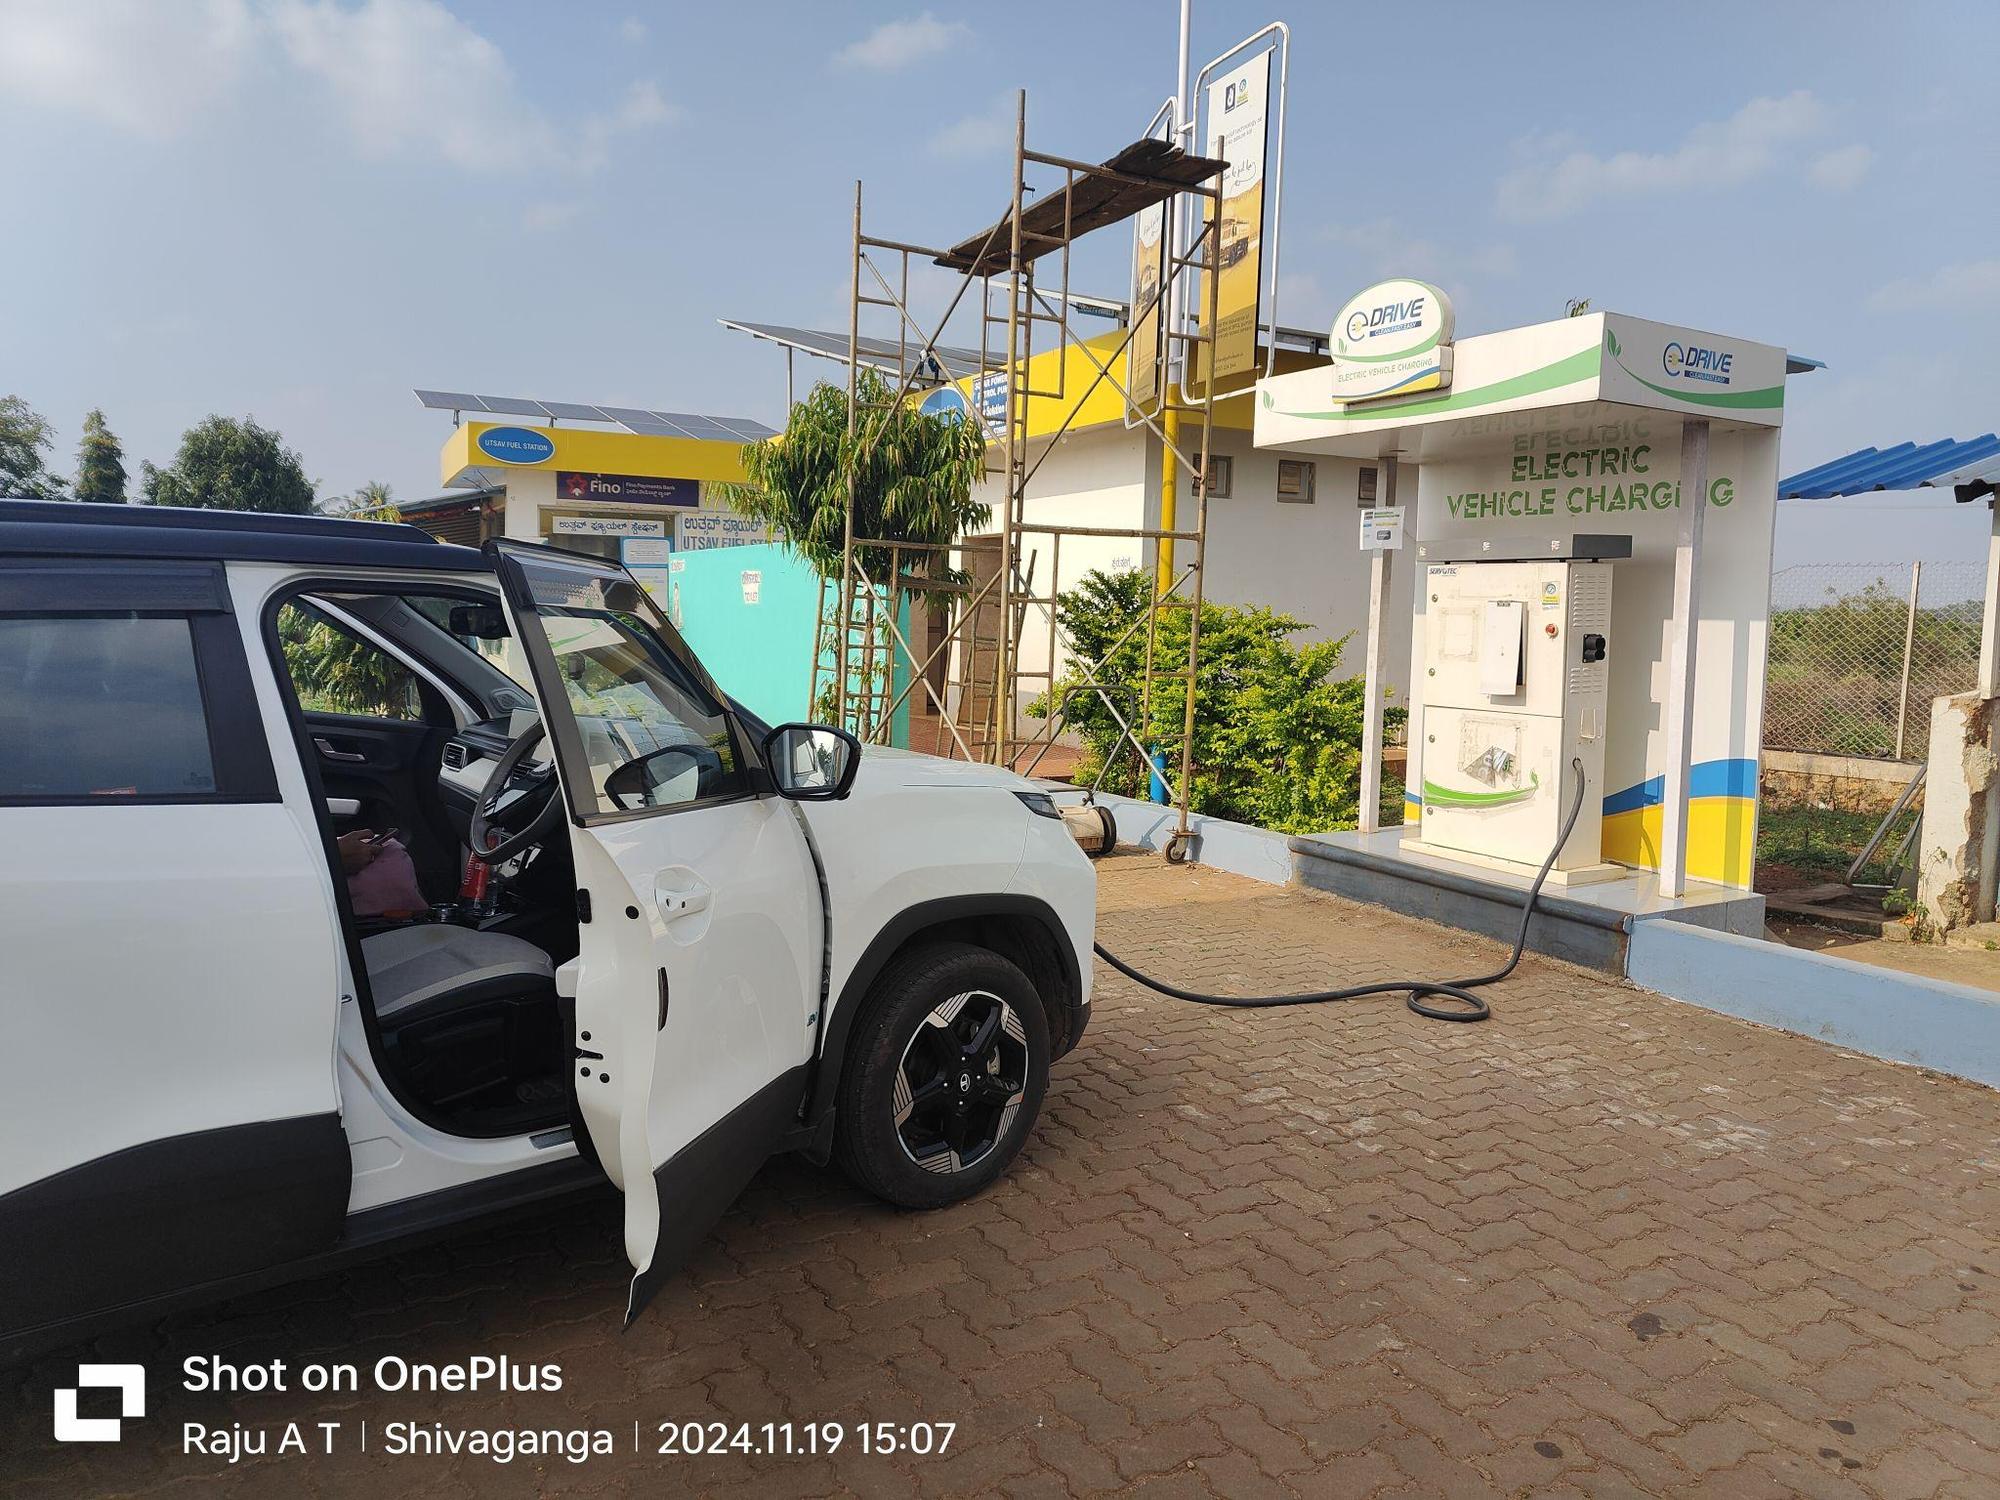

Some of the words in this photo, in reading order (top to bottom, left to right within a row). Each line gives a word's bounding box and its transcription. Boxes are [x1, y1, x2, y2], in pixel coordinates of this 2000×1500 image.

[1338, 370, 1367, 382] ELECTRIC
[1368, 364, 1396, 376] VEHICLE
[1397, 358, 1433, 371] CHARGING
[484, 439, 506, 448] UTSAV
[506, 441, 522, 449] FUEL
[522, 442, 548, 451] STATION
[1511, 445, 1651, 482] ELECTRIC
[590, 473, 621, 494] Fino
[1446, 488, 1556, 519] VEHICLE
[1565, 477, 1734, 514] CHARGIG
[683, 535, 719, 550] UTSAV
